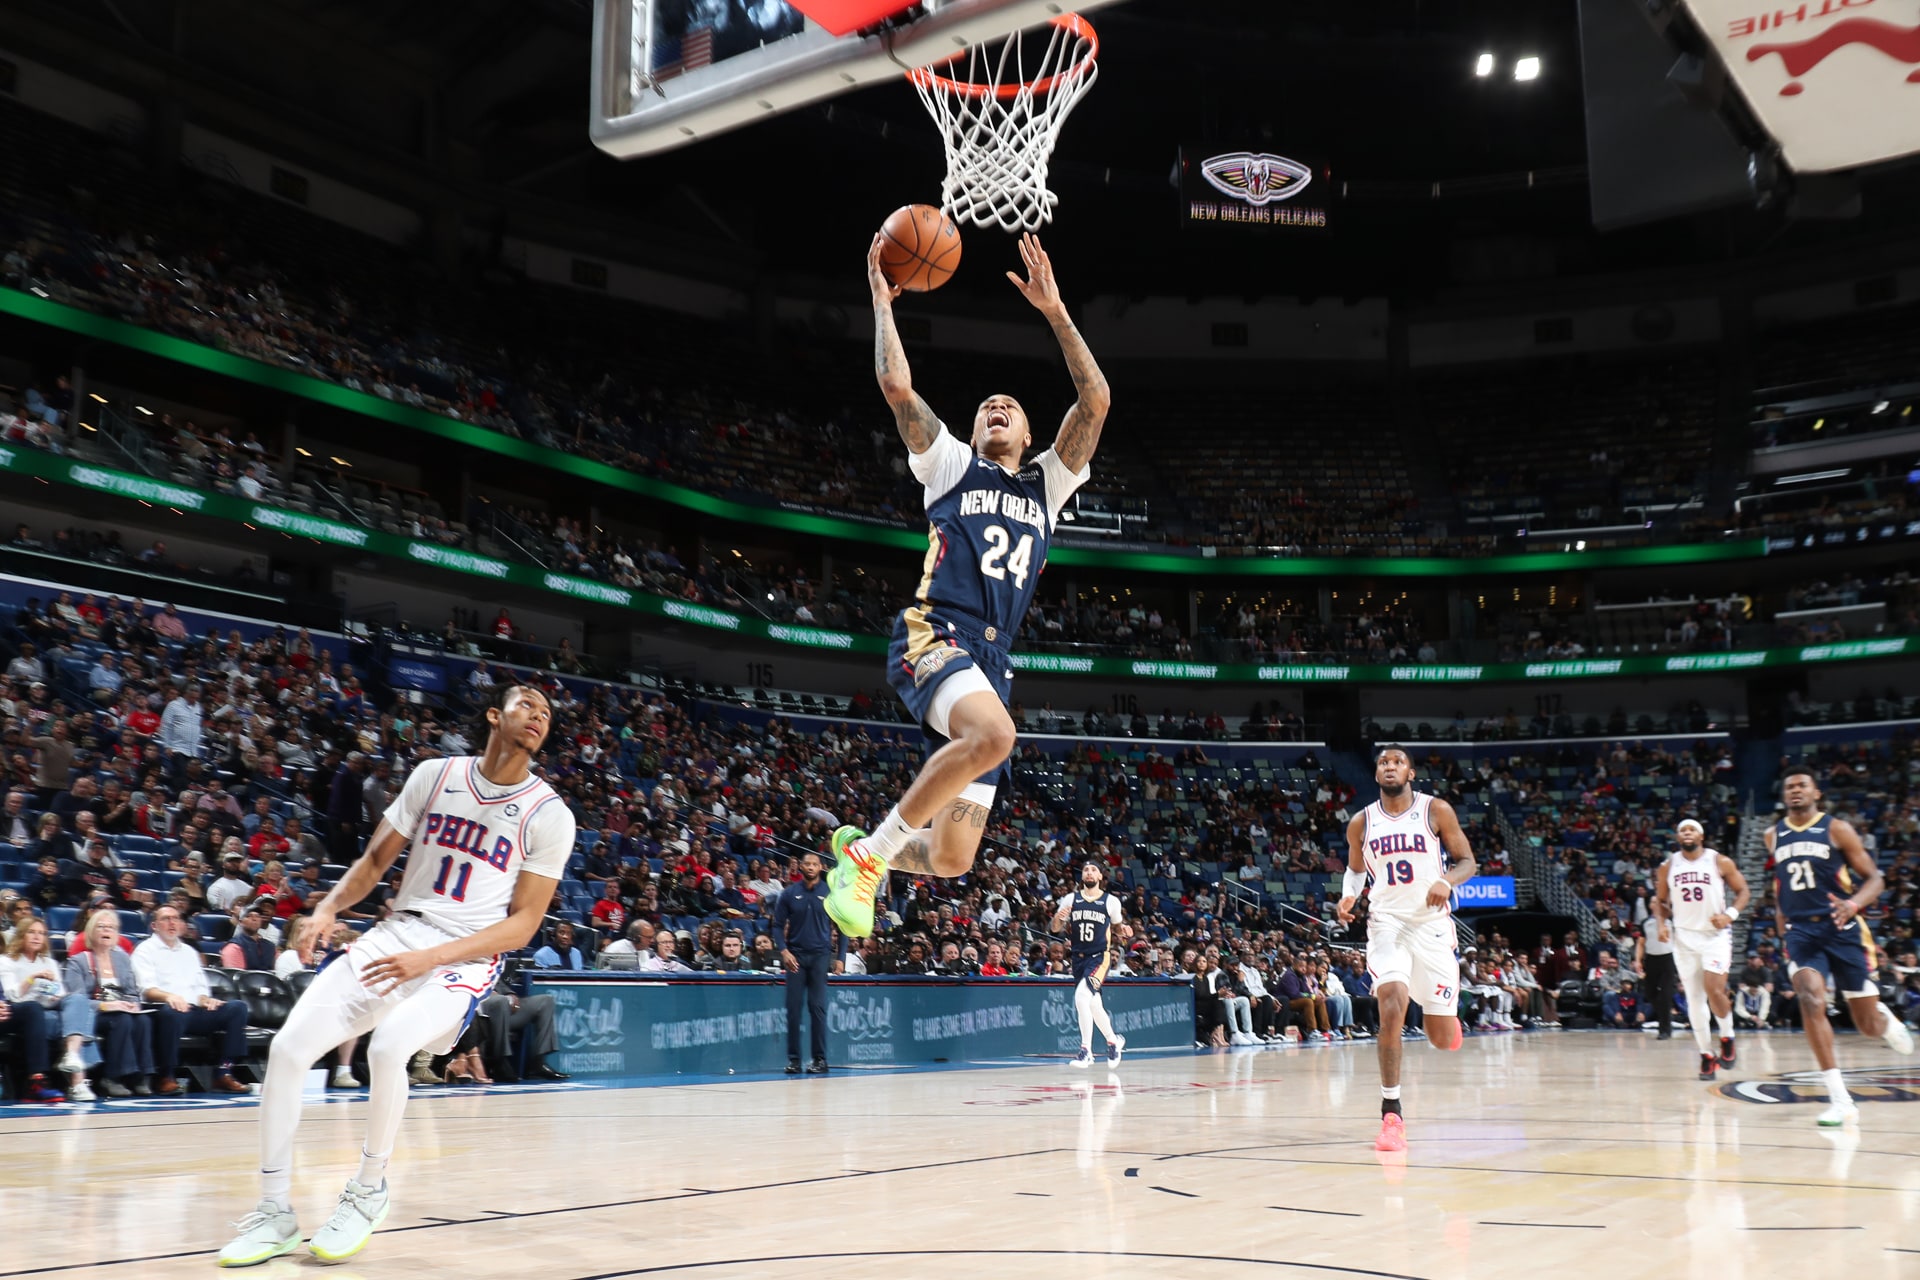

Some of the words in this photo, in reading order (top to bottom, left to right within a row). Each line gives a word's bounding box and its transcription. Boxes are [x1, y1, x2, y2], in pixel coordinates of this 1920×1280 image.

[1728, 0, 1878, 38] THIE
[1190, 202, 1218, 220] NEW
[1220, 203, 1271, 225] ORLEANS
[1273, 205, 1327, 228] PELICANS
[960, 489, 1001, 516] NEW
[980, 524, 1035, 561] 24
[818, 632, 853, 648] THIRST
[746, 662, 774, 687] 115
[1059, 657, 1094, 672] THIRST
[1132, 661, 1158, 675] OBEY
[1183, 664, 1217, 679] THIRST
[1258, 666, 1286, 679] OBEY
[1314, 666, 1350, 680] THIRST
[1391, 666, 1418, 680] OBEY
[1447, 665, 1483, 680] THIRST
[1525, 663, 1554, 677] OBEY
[1585, 660, 1624, 674] THIRST
[1112, 693, 1137, 715] 116
[422, 813, 514, 873] PHILA
[1369, 833, 1427, 859] PHILA
[433, 854, 473, 903] 11
[1386, 859, 1414, 887] 19
[1674, 871, 1712, 887] PHILA
[1786, 859, 1817, 892] 21
[1681, 886, 1704, 902] 28
[1082, 909, 1106, 925] ORLEANS
[1078, 922, 1095, 942] 15
[1434, 983, 1452, 999] 76
[555, 997, 624, 1037] astal
[826, 996, 894, 1034] Coastal
[1041, 993, 1079, 1028] Coast
[1152, 1005, 1163, 1027] FOR
[925, 1016, 942, 1041] HAVE
[942, 1014, 960, 1038] SOME
[975, 1008, 989, 1032] FOR
